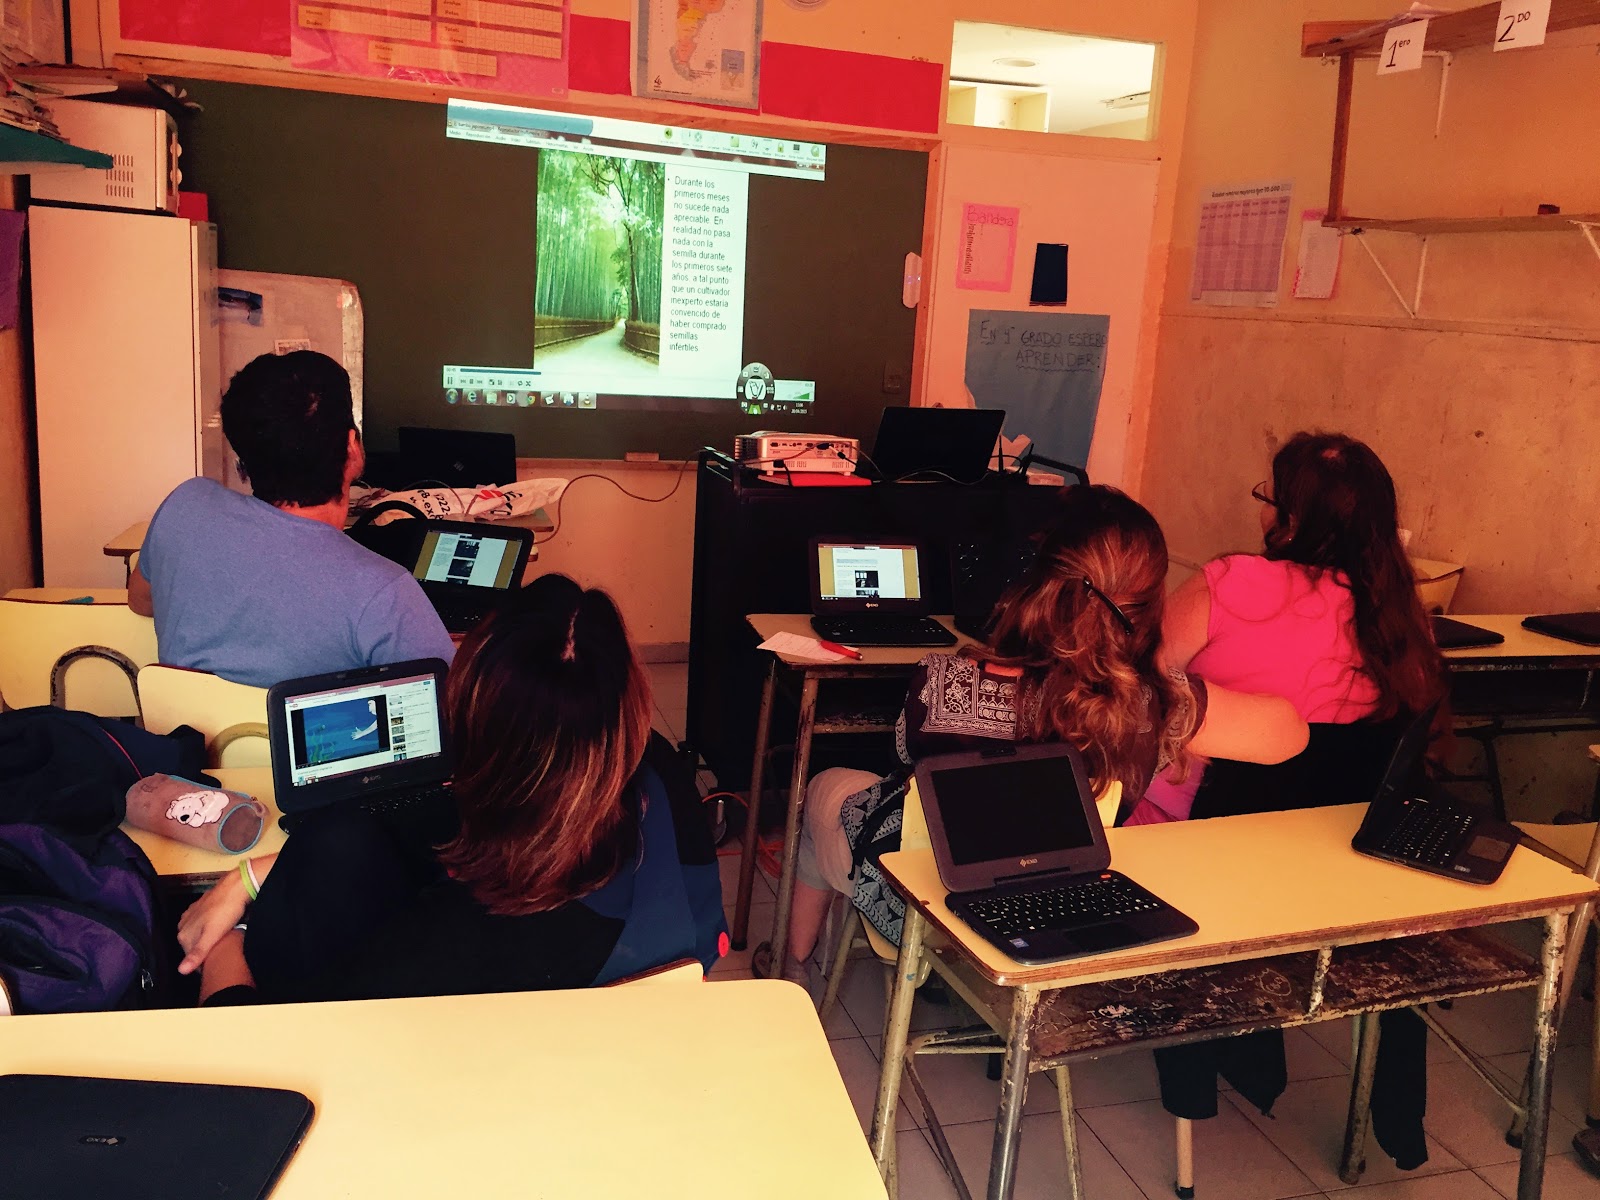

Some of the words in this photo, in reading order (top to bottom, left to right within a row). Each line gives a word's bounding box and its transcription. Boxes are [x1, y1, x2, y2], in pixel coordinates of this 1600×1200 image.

[674, 176, 702, 187] Durante
[704, 179, 715, 188] los
[674, 189, 705, 199] primeros
[707, 193, 730, 202] meses
[684, 202, 710, 212] sucede
[712, 203, 729, 214] nada
[714, 216, 724, 225] En
[673, 226, 702, 236] realidad
[714, 230, 731, 238] pasa
[672, 237, 690, 246] nada
[707, 240, 713, 248] la
[672, 249, 696, 259] semilla
[699, 250, 725, 261] durante
[672, 260, 682, 269] los
[684, 262, 715, 272] primeros
[716, 264, 732, 273] siete
[699, 274, 708, 283] tal
[709, 276, 729, 285] punto
[672, 286, 684, 294] que
[697, 287, 730, 296] cultivador
[670, 297, 703, 308] inexperto
[670, 308, 710, 318] convencido
[712, 310, 720, 319] de
[670, 319, 690, 329] haber
[692, 321, 727, 331] comprado
[670, 331, 698, 341] semillas
[1021, 330, 1062, 344] GRADO
[1068, 332, 1107, 346] ESPERO
